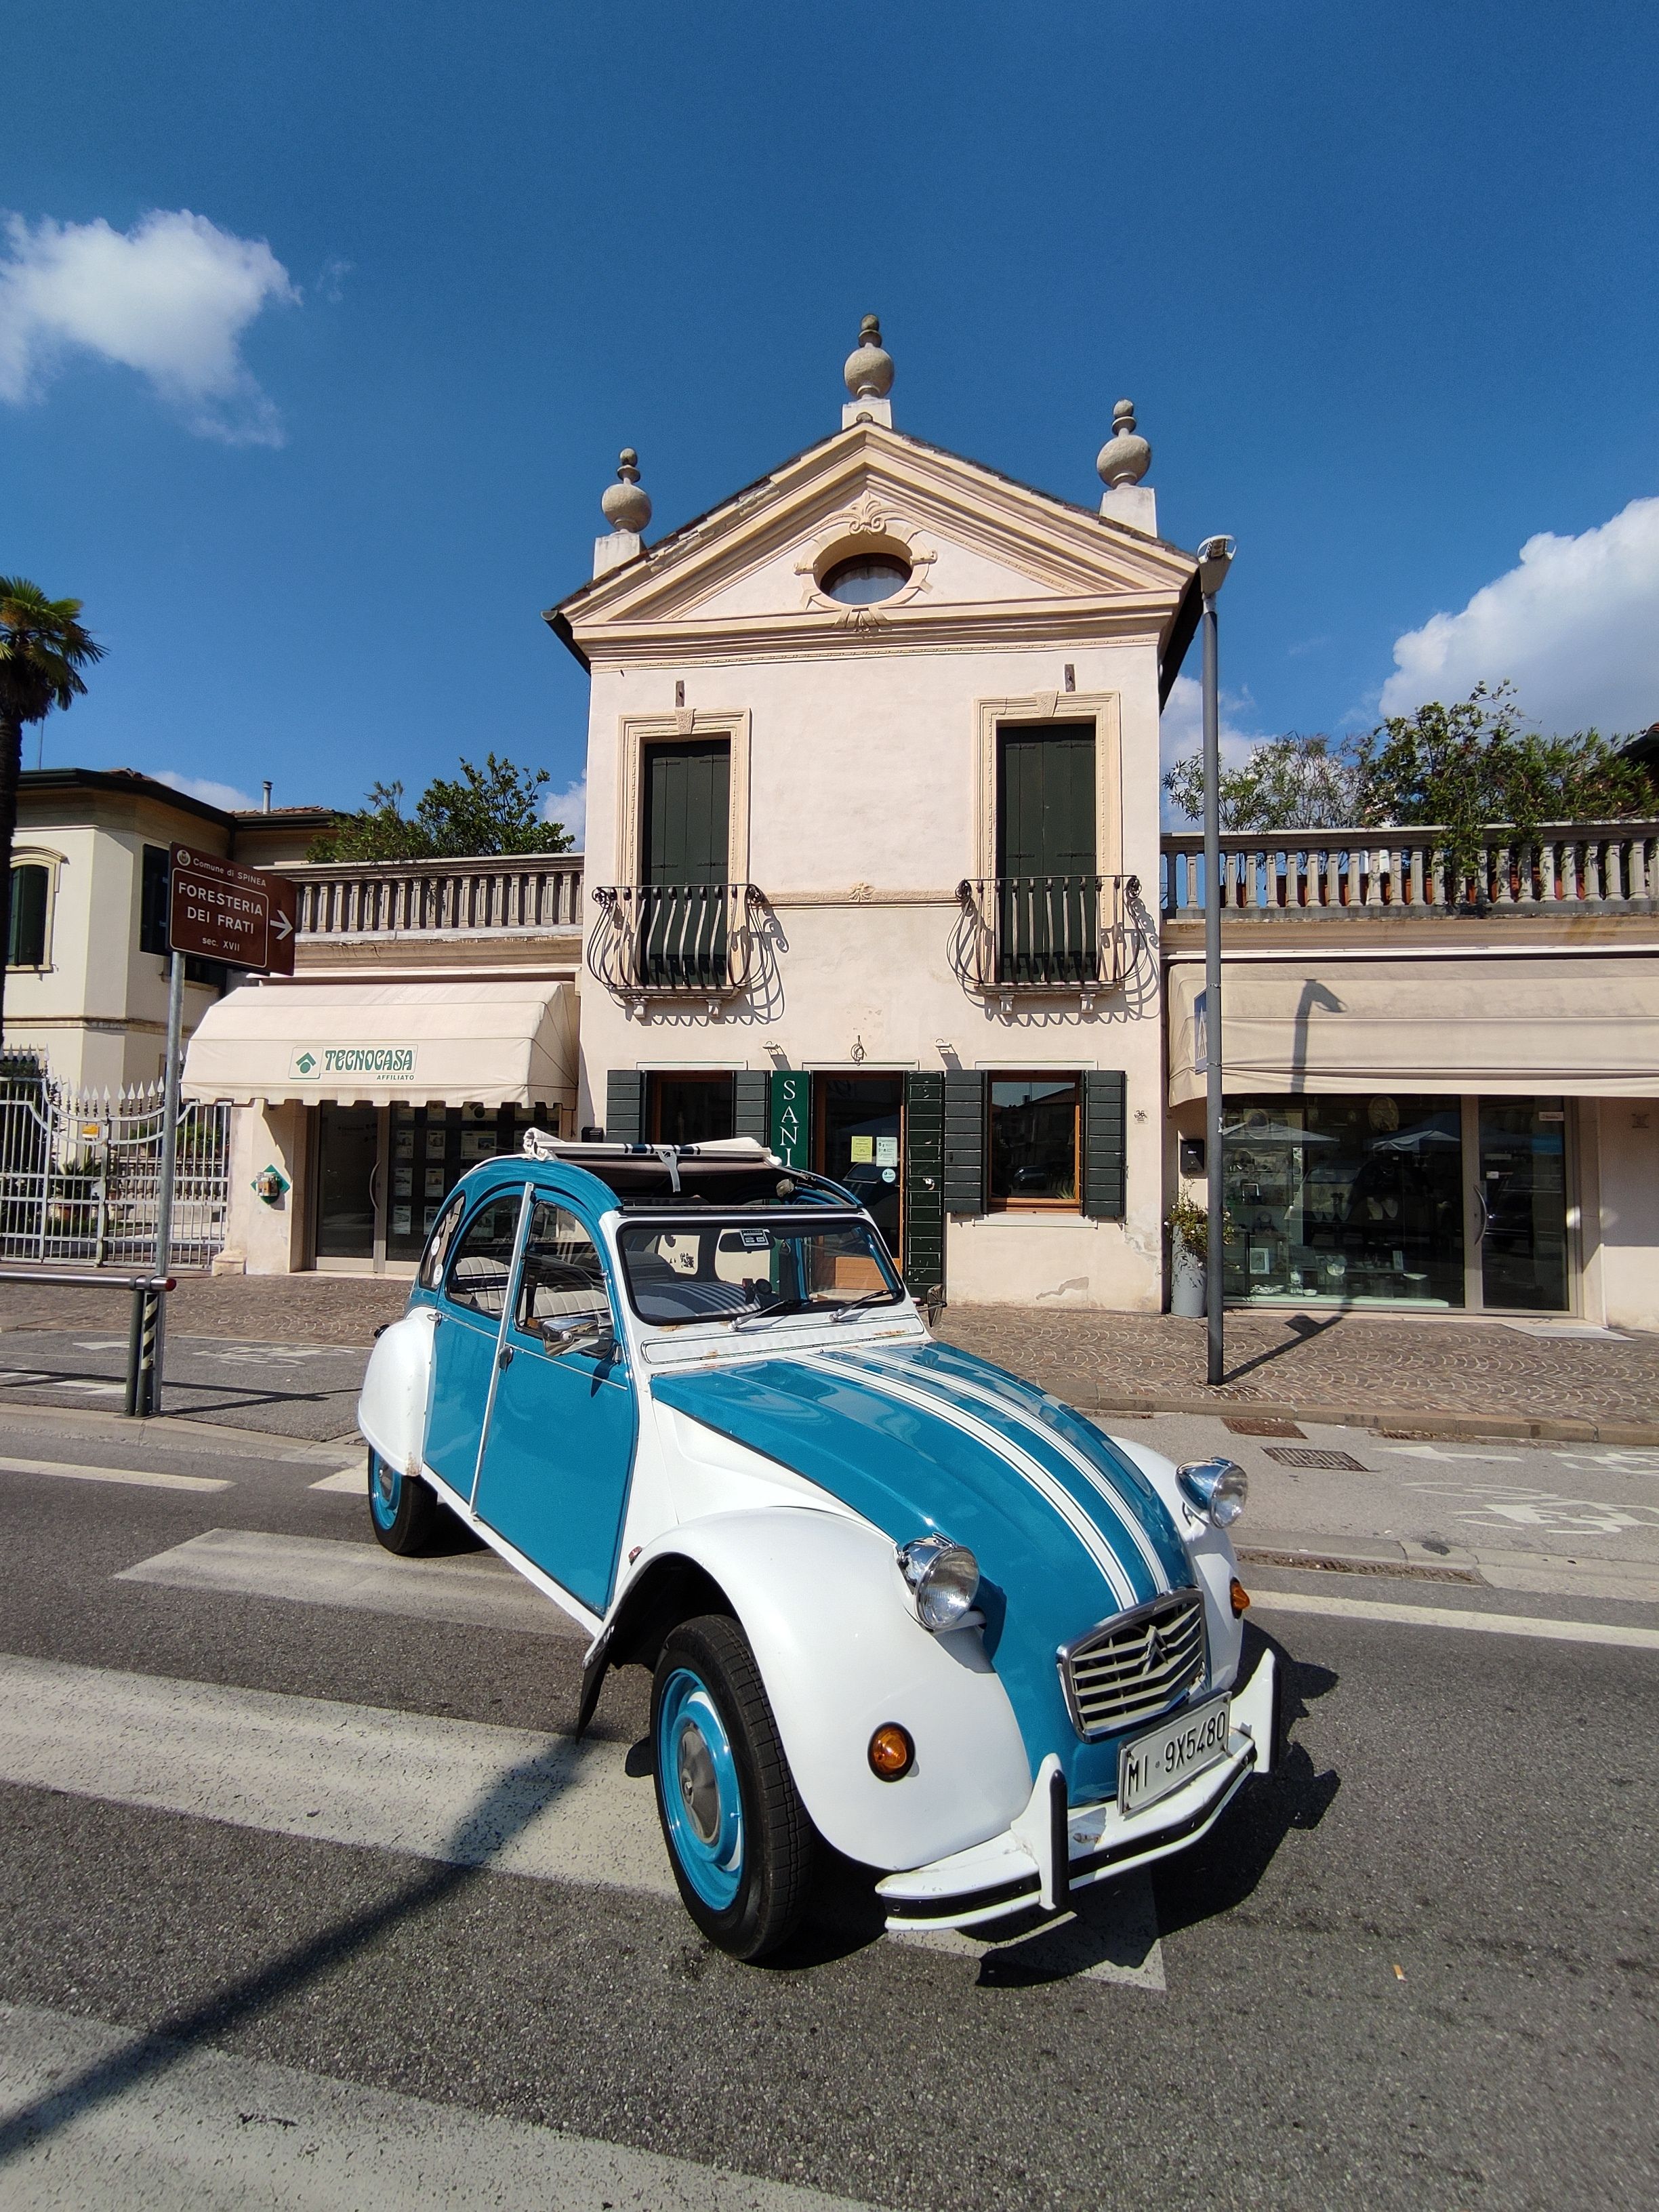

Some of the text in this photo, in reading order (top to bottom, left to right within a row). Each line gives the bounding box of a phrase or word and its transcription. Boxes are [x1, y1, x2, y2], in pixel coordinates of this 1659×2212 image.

[193, 858, 266, 886] Comune di SPINEA
[178, 882, 263, 916] FORESTERIA
[187, 906, 254, 934] DEI FRATI
[202, 937, 240, 951] sec. XVII
[325, 1050, 413, 1071] TECNOCASA
[1127, 1711, 1226, 1797] MI 9X5480
